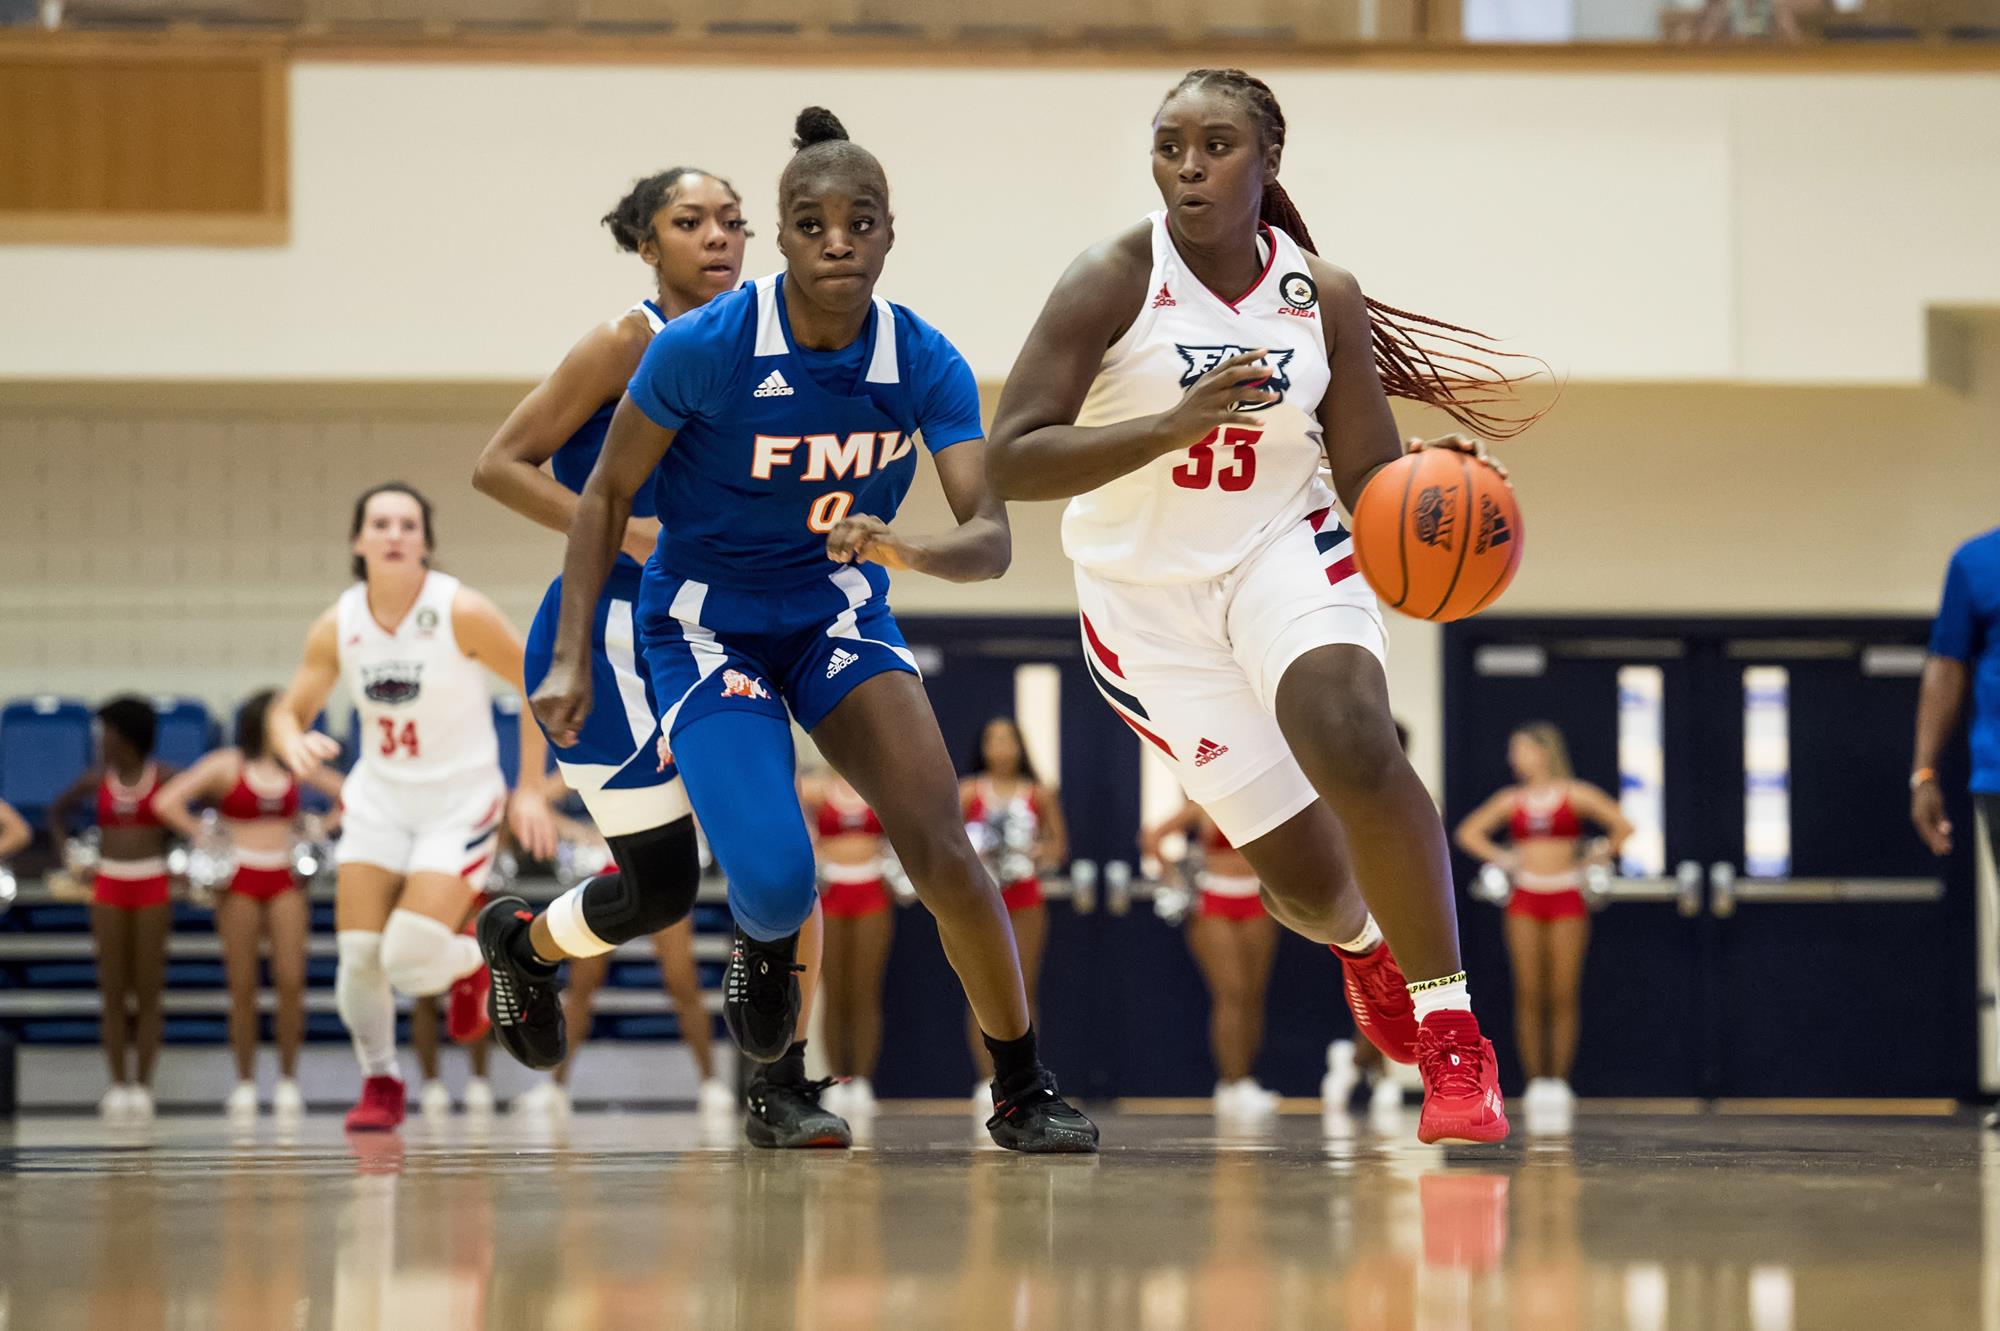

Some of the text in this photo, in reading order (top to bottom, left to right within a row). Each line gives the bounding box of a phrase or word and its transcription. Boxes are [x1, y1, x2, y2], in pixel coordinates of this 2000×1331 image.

[1277, 307, 1316, 320] C-USA
[753, 386, 795, 398] adidas
[1172, 426, 1264, 492] 33
[807, 490, 854, 534] 0
[826, 653, 859, 679] adidas
[378, 715, 420, 758] 34
[1195, 745, 1229, 767] adidas
